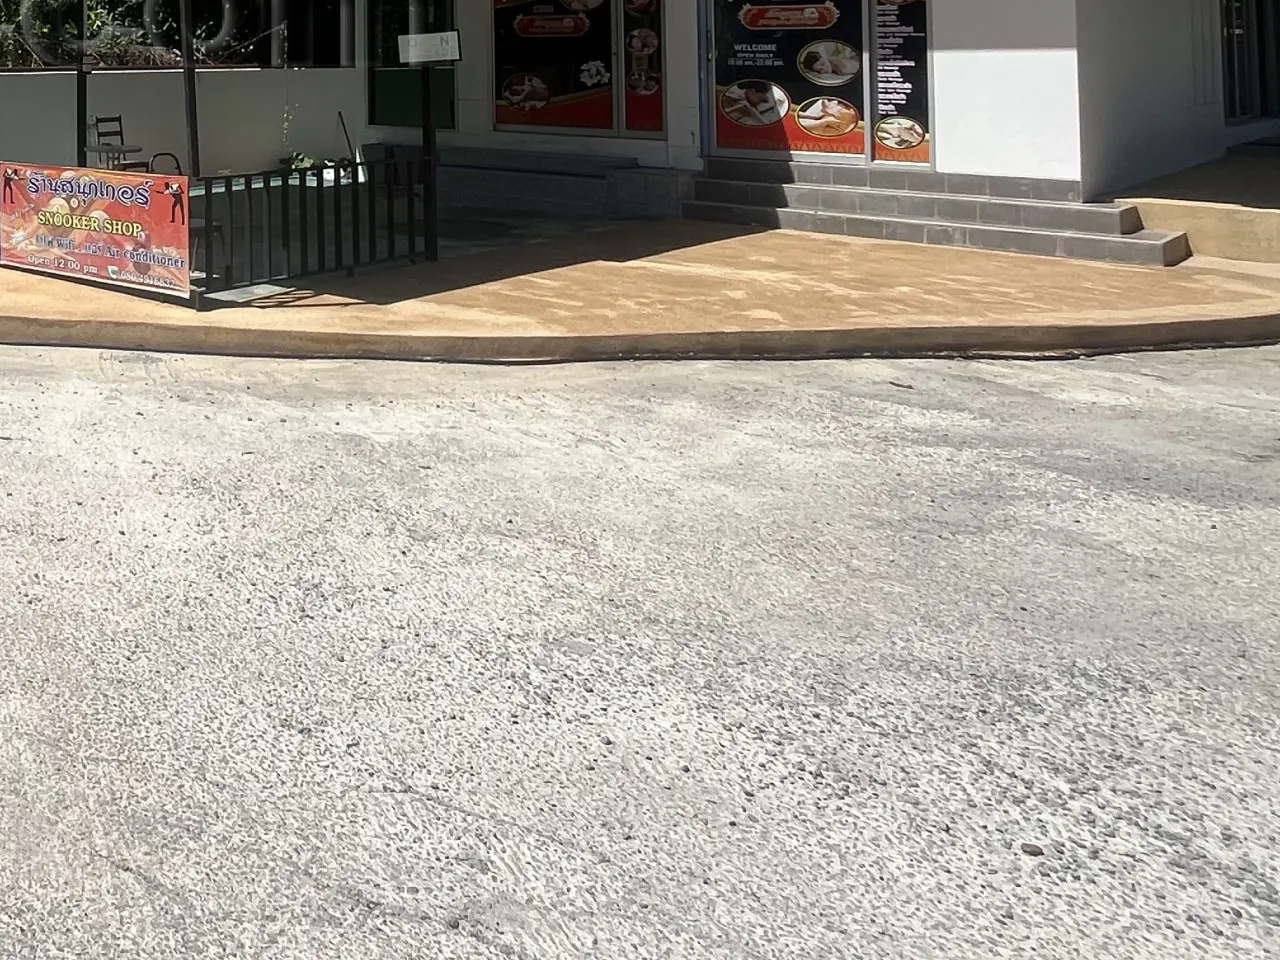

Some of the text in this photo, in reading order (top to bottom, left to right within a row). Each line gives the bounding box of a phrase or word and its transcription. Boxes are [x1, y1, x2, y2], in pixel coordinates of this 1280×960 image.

[733, 43, 777, 51] WELCOME
[27, 171, 155, 210] ร้านสนุกเกอร์
[37, 211, 143, 238] SNOOKER SHOP
[27, 254, 50, 266] Open
[83, 264, 99, 274] pm
[55, 236, 75, 251] Wifi
[105, 245, 121, 259] Air
[124, 248, 185, 269] conditioner
